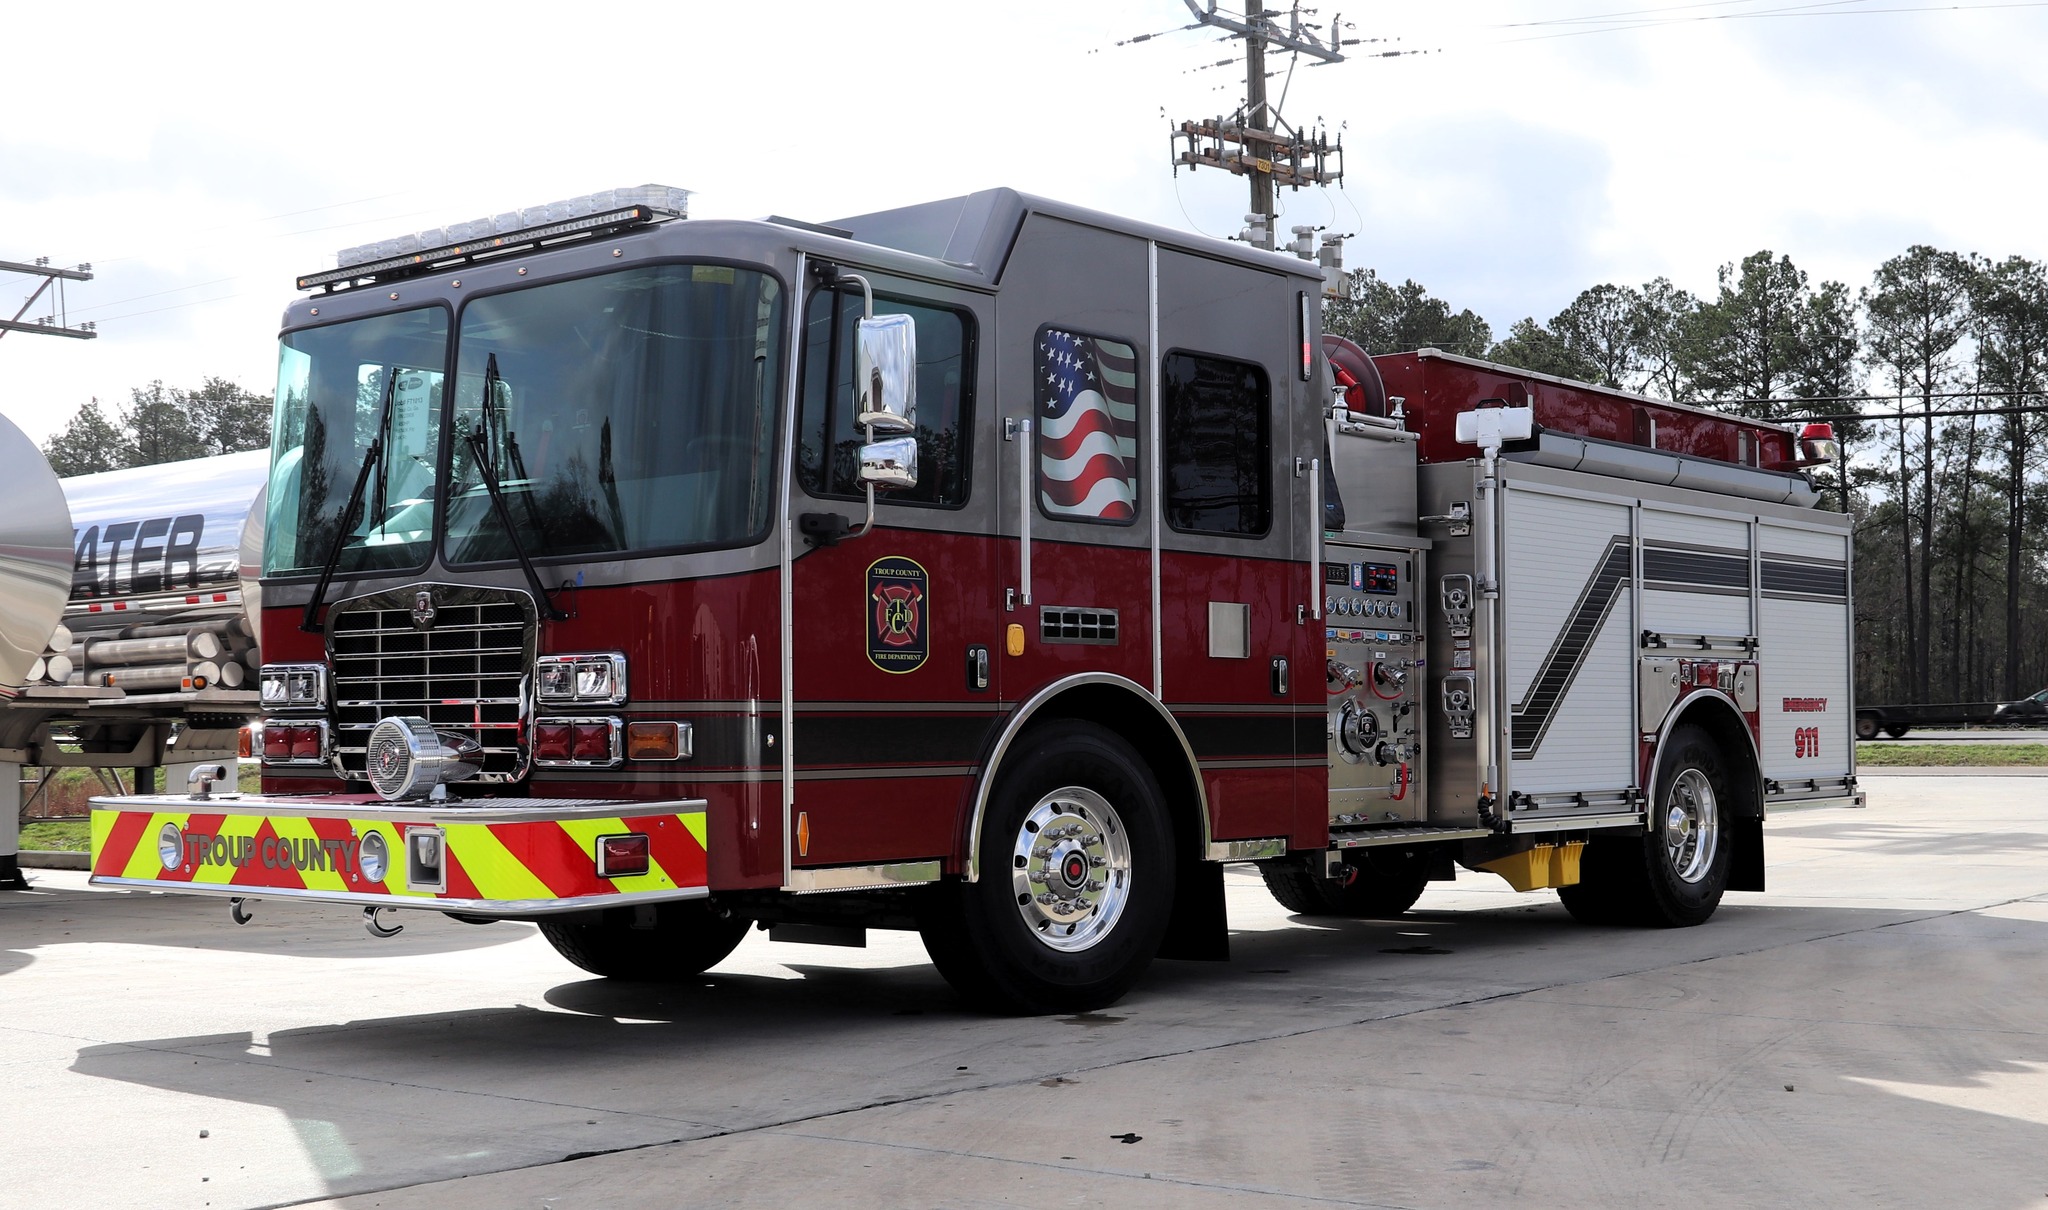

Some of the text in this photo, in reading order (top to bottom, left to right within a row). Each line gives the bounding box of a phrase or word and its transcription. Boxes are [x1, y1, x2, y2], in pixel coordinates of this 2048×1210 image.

[1258, 160, 1270, 172] 7301
[73, 514, 205, 598] ATER
[874, 567, 920, 577] TROUP COUNTY
[888, 653, 922, 661] DEPARTMENT
[1782, 697, 1828, 713] EMERGENCY
[1794, 726, 1819, 759] 911
[185, 833, 357, 873] TROUP COUNTY
